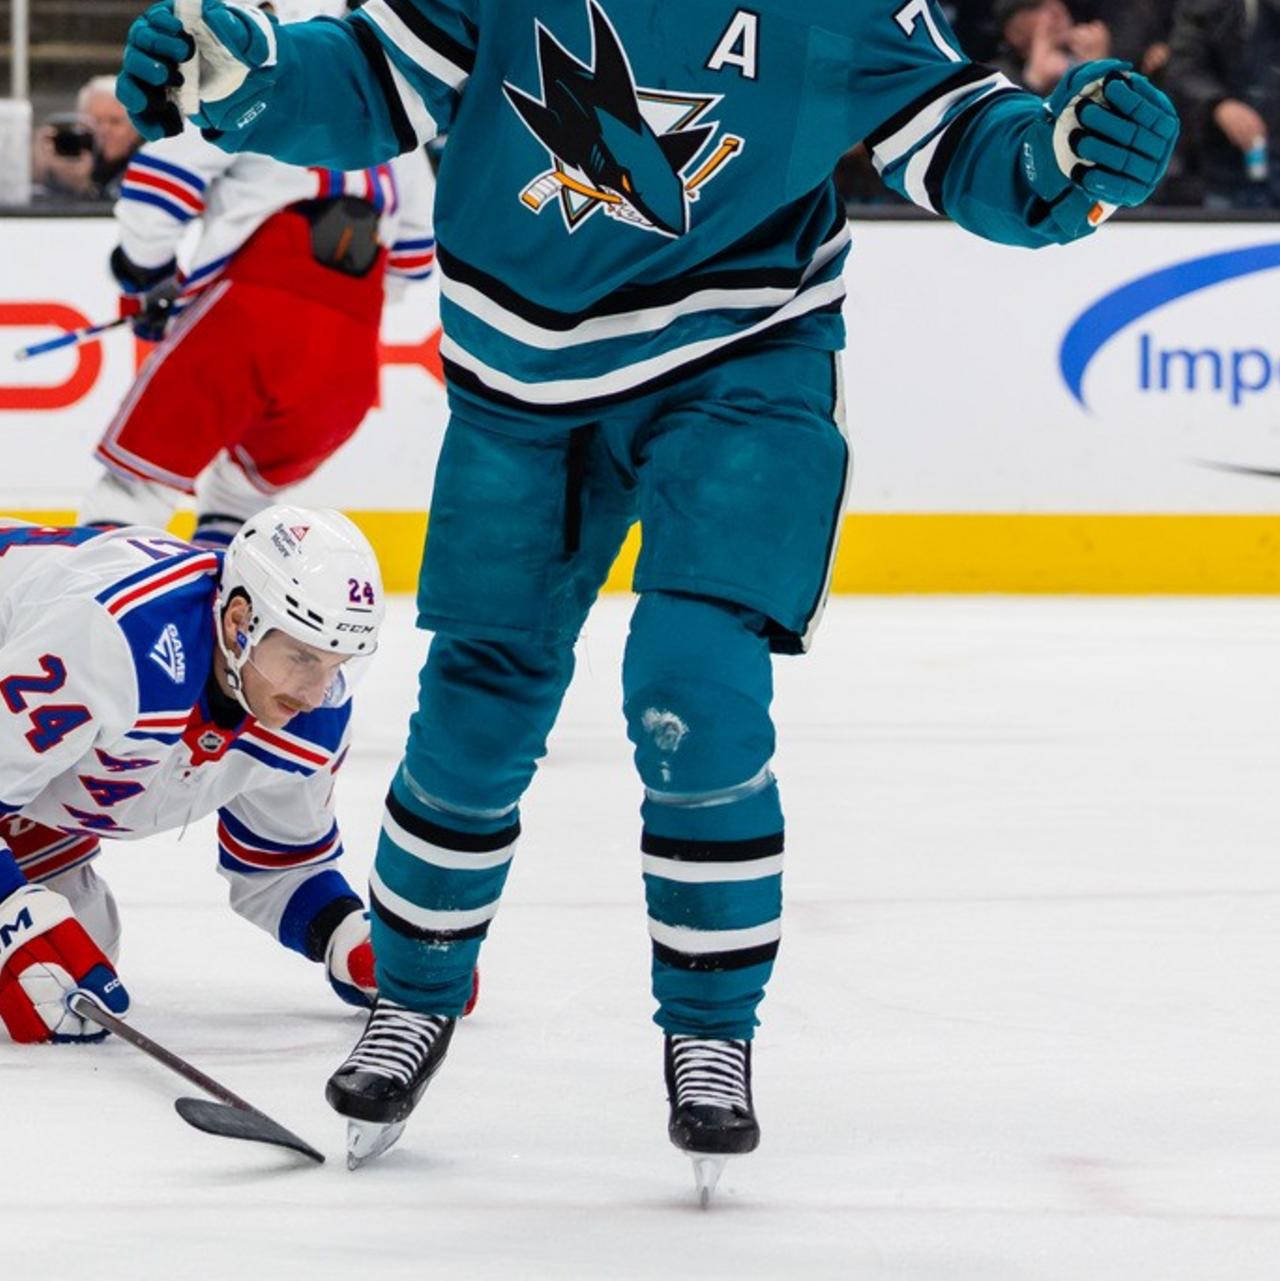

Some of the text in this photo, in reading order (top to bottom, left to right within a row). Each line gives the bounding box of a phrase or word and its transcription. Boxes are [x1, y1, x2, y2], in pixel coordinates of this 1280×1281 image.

[707, 9, 760, 81] A
[348, 578, 375, 605] 24
[336, 622, 375, 634] CCM
